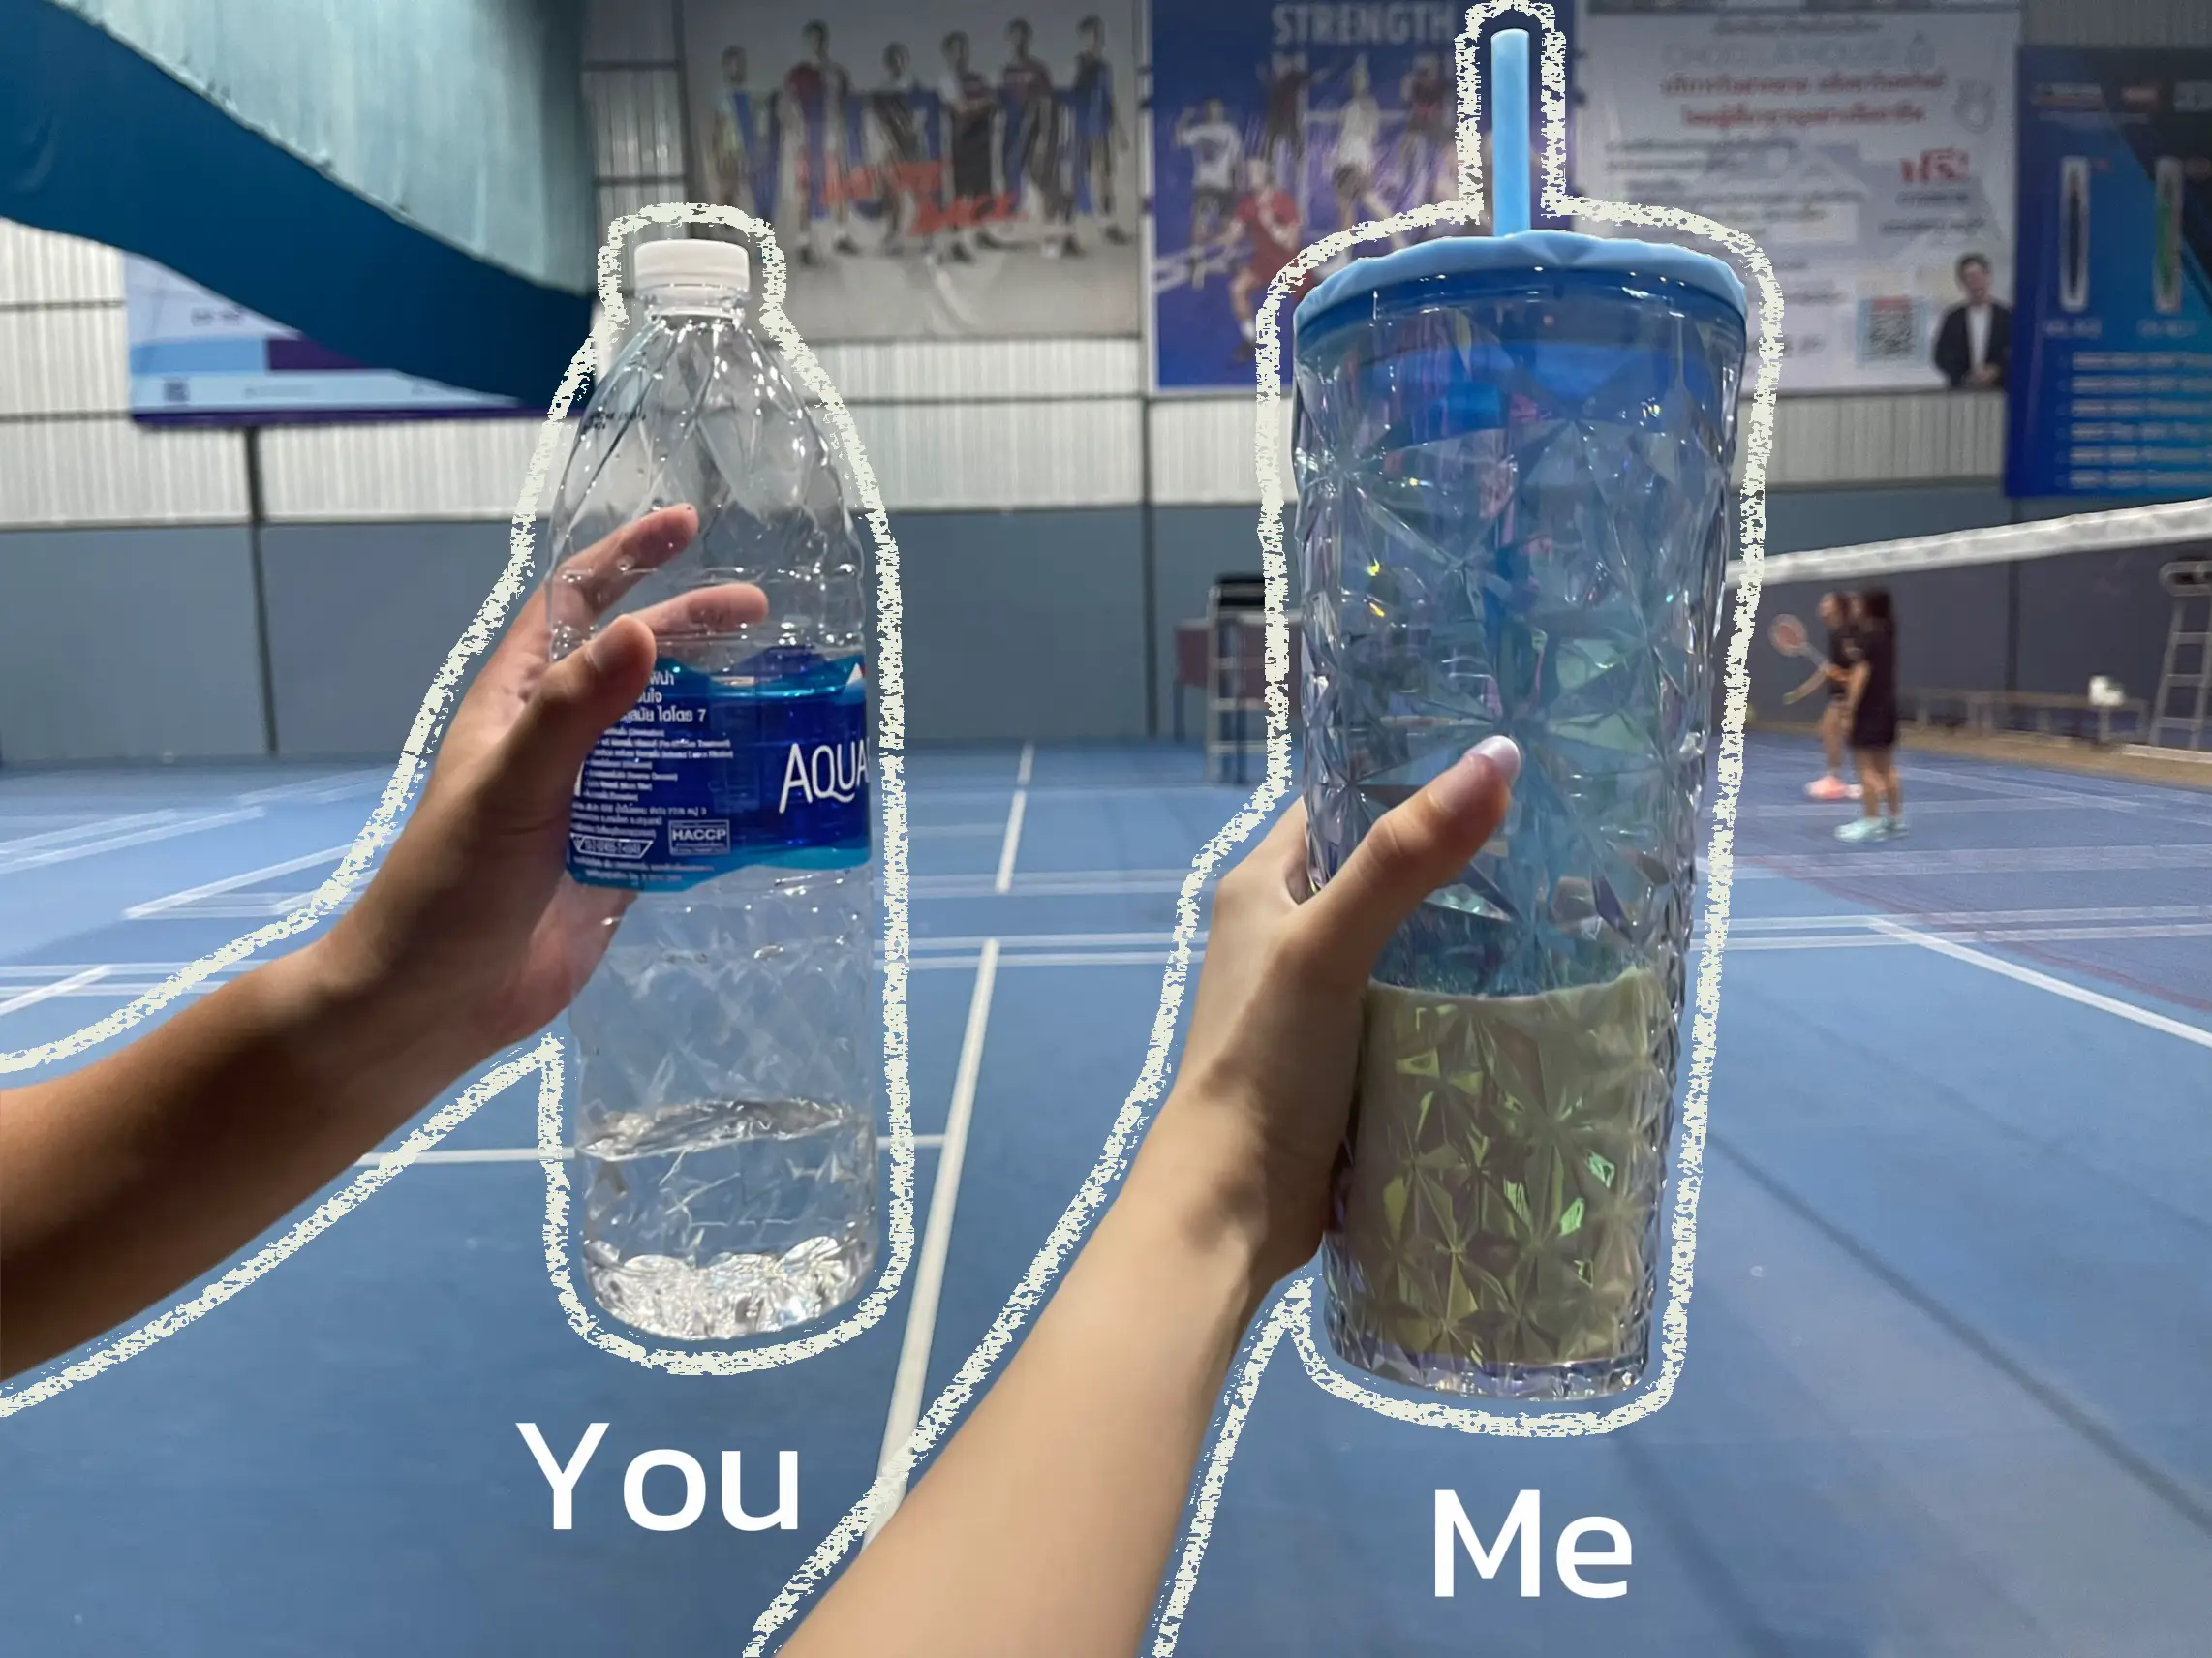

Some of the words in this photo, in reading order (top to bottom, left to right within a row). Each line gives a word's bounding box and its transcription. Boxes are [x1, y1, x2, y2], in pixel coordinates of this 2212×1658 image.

[1271, 3, 1457, 46] STRENGTH
[697, 708, 707, 722] 7
[779, 738, 870, 814] AQUA
[672, 828, 726, 841] HACCP
